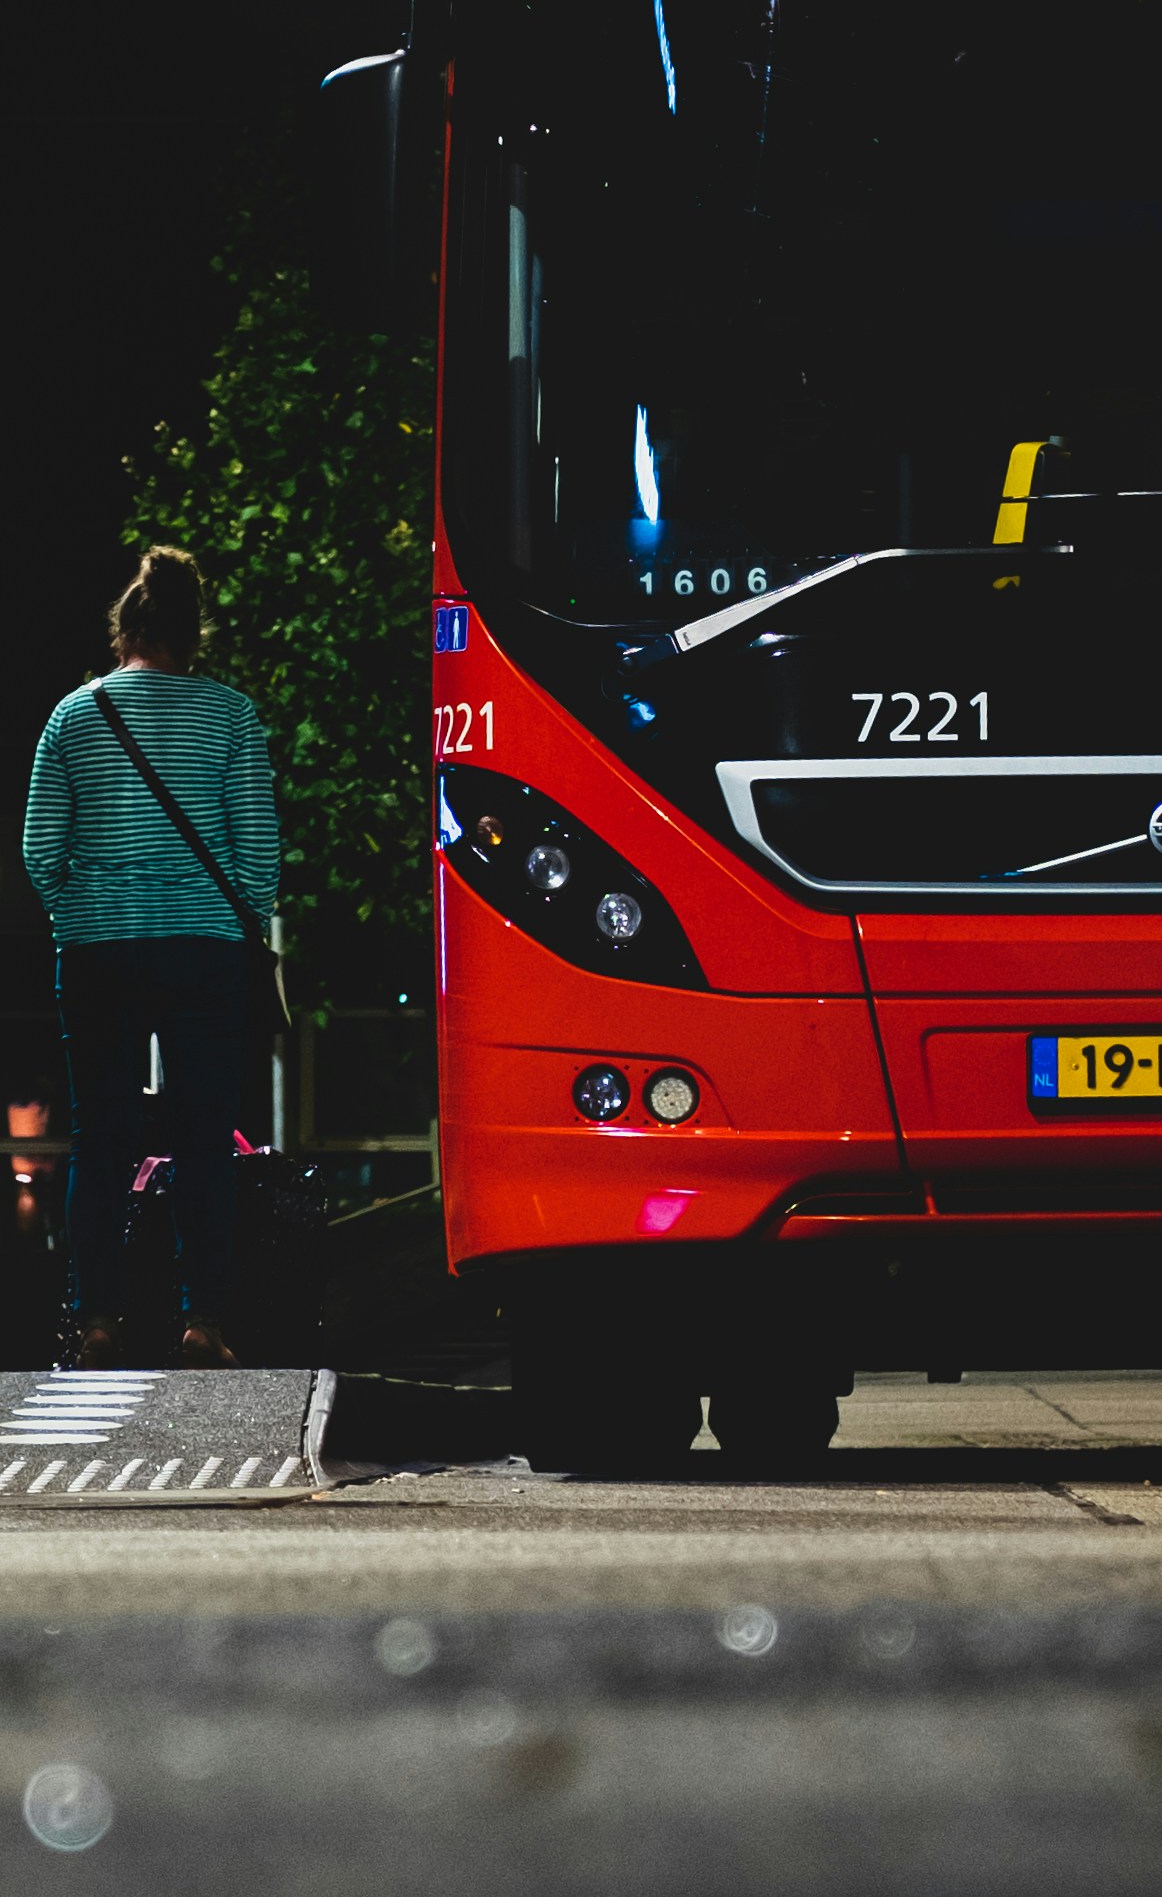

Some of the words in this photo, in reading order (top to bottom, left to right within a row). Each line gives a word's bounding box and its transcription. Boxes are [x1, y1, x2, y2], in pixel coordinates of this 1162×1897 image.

[434, 701, 494, 755] 7221
[852, 692, 989, 742] 7221
[1034, 1073, 1054, 1088] NL
